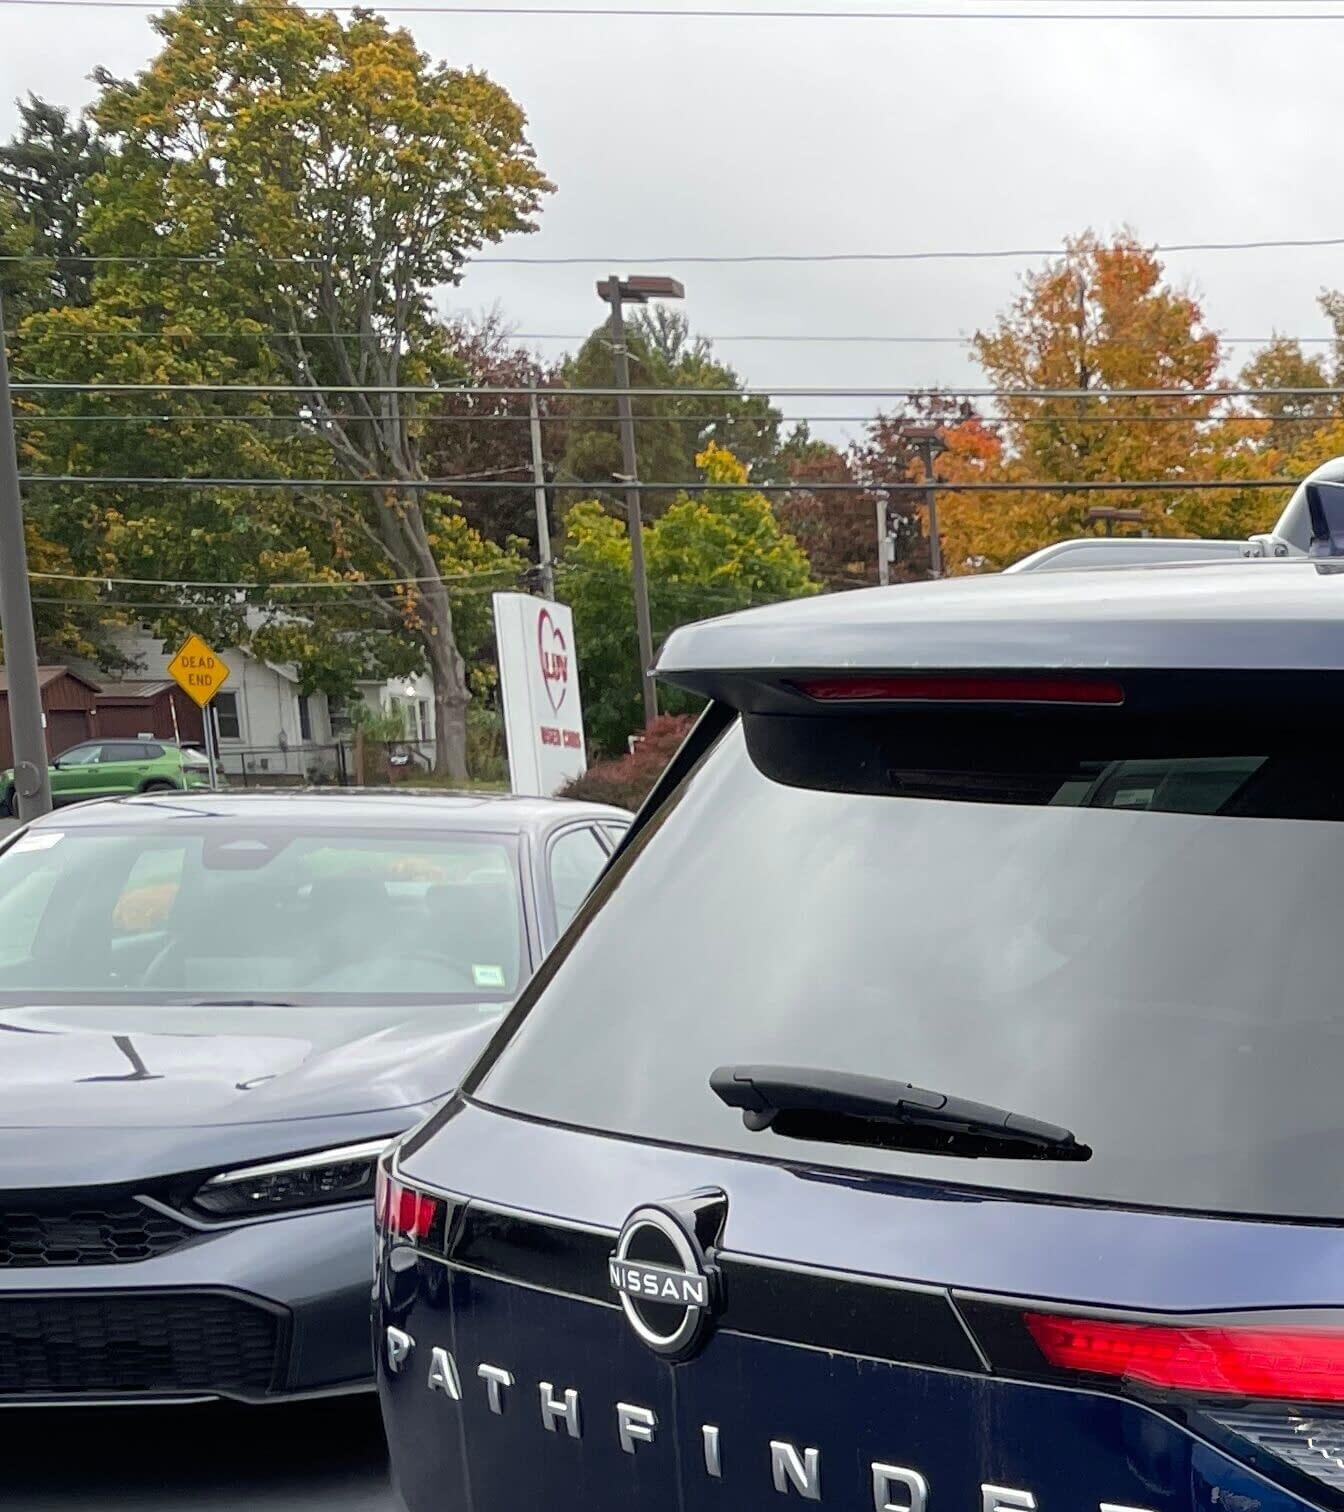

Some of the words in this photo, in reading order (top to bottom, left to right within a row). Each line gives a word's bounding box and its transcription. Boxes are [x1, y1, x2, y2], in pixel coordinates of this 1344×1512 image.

[181, 655, 215, 669] DEAD
[188, 673, 213, 686] END
[609, 1263, 703, 1303] NISSAN
